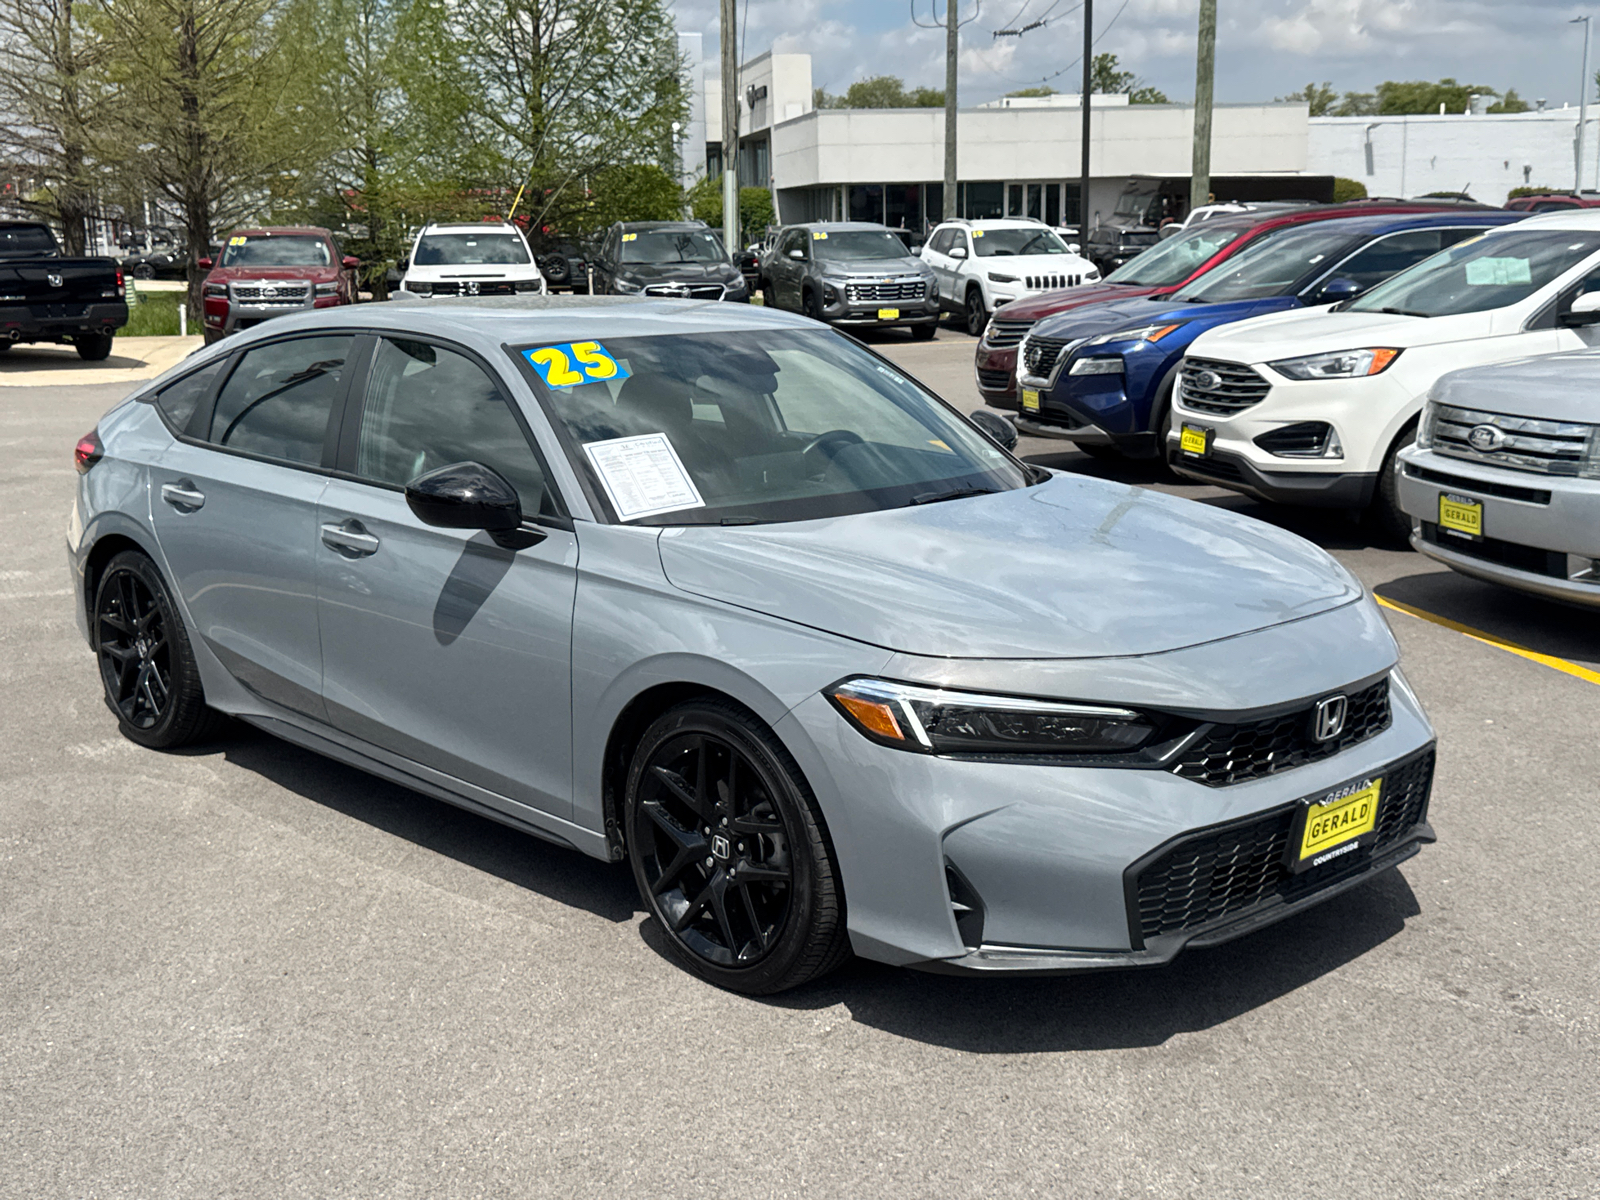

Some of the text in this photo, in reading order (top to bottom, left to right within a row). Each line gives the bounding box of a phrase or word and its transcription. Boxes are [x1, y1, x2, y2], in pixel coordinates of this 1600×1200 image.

[530, 341, 618, 386] 25
[1445, 508, 1477, 525] GERALD
[1325, 778, 1372, 804] GERALD
[1311, 803, 1368, 839] GERALD
[1313, 840, 1359, 866] COUNTRYSIDE
